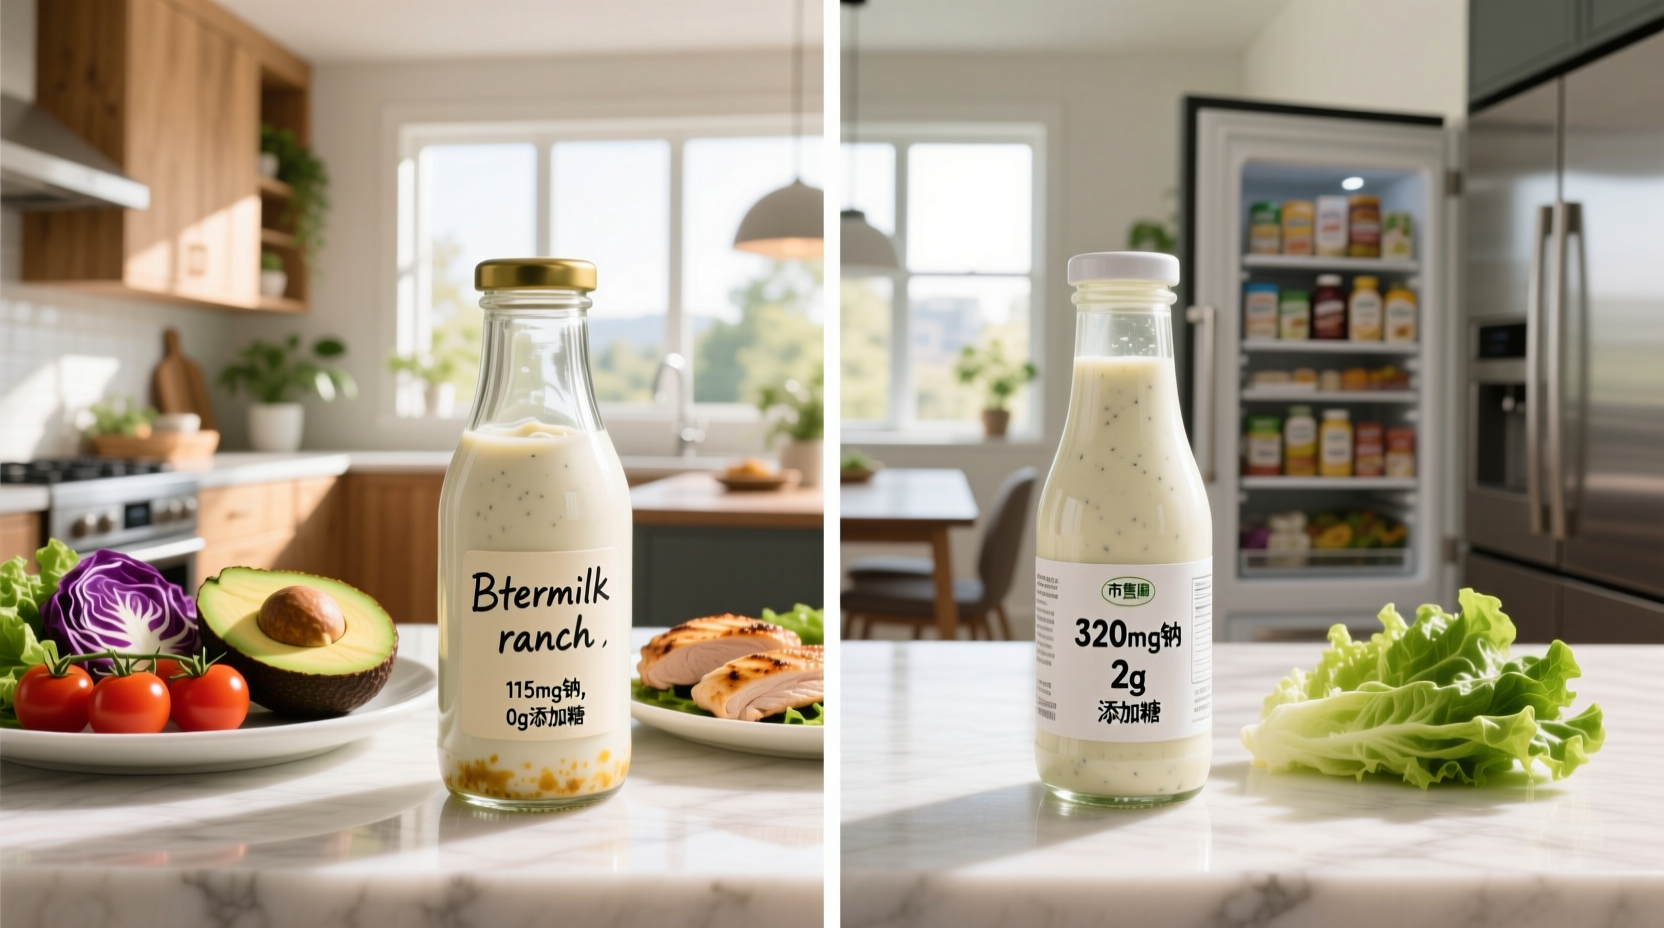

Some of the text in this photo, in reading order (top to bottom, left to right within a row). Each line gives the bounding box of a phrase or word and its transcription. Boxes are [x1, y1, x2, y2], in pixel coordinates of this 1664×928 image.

[472, 565, 610, 612] Btermilk
[1074, 617, 1182, 654] 320mg钠
[1110, 659, 1146, 697] 2g
[505, 704, 586, 732] 0g添加糖
[1097, 699, 1161, 725] 添加糖
